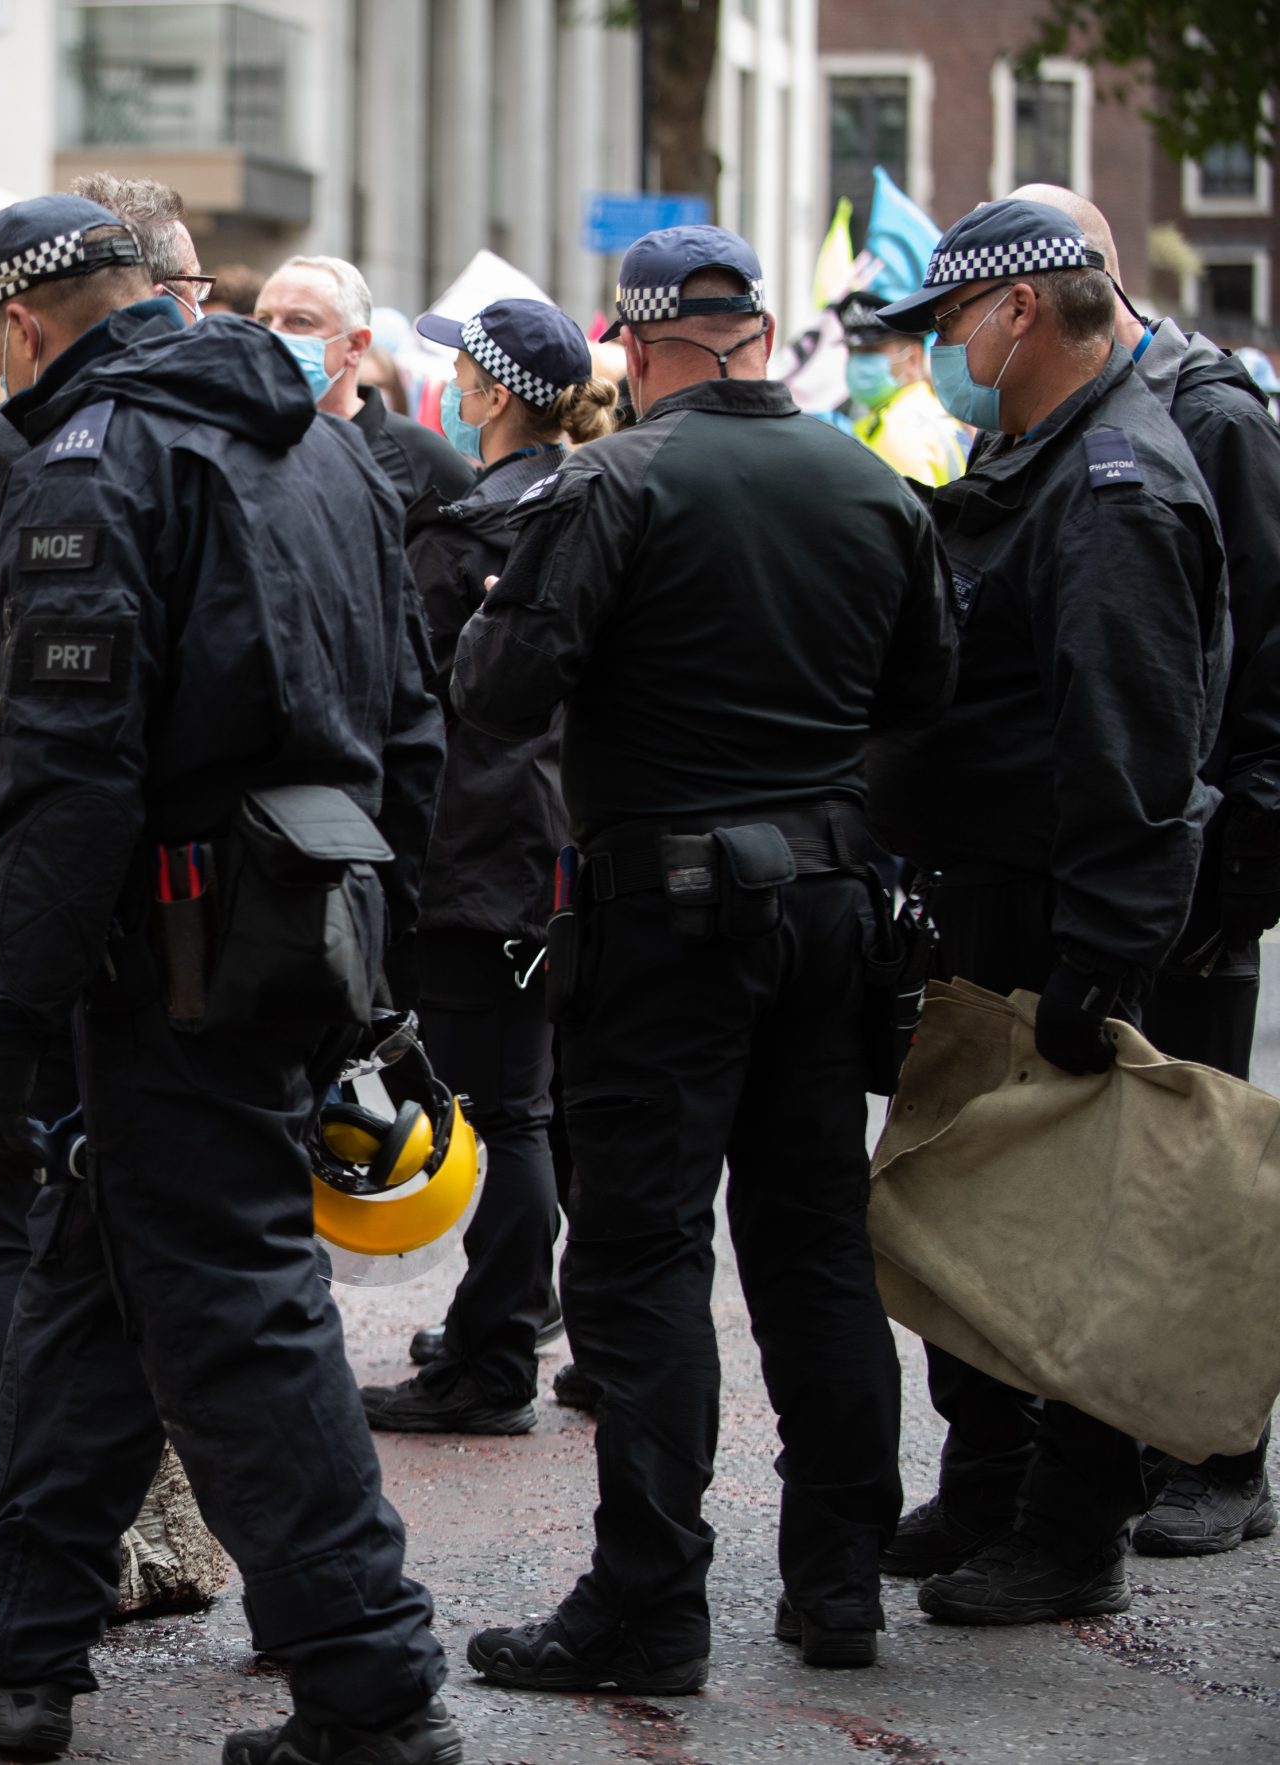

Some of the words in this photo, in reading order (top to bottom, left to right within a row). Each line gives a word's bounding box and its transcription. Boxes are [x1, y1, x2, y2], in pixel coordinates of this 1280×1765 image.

[1089, 460, 1134, 472] PHANTOM
[31, 534, 84, 560] MOE
[46, 645, 96, 670] PRT
